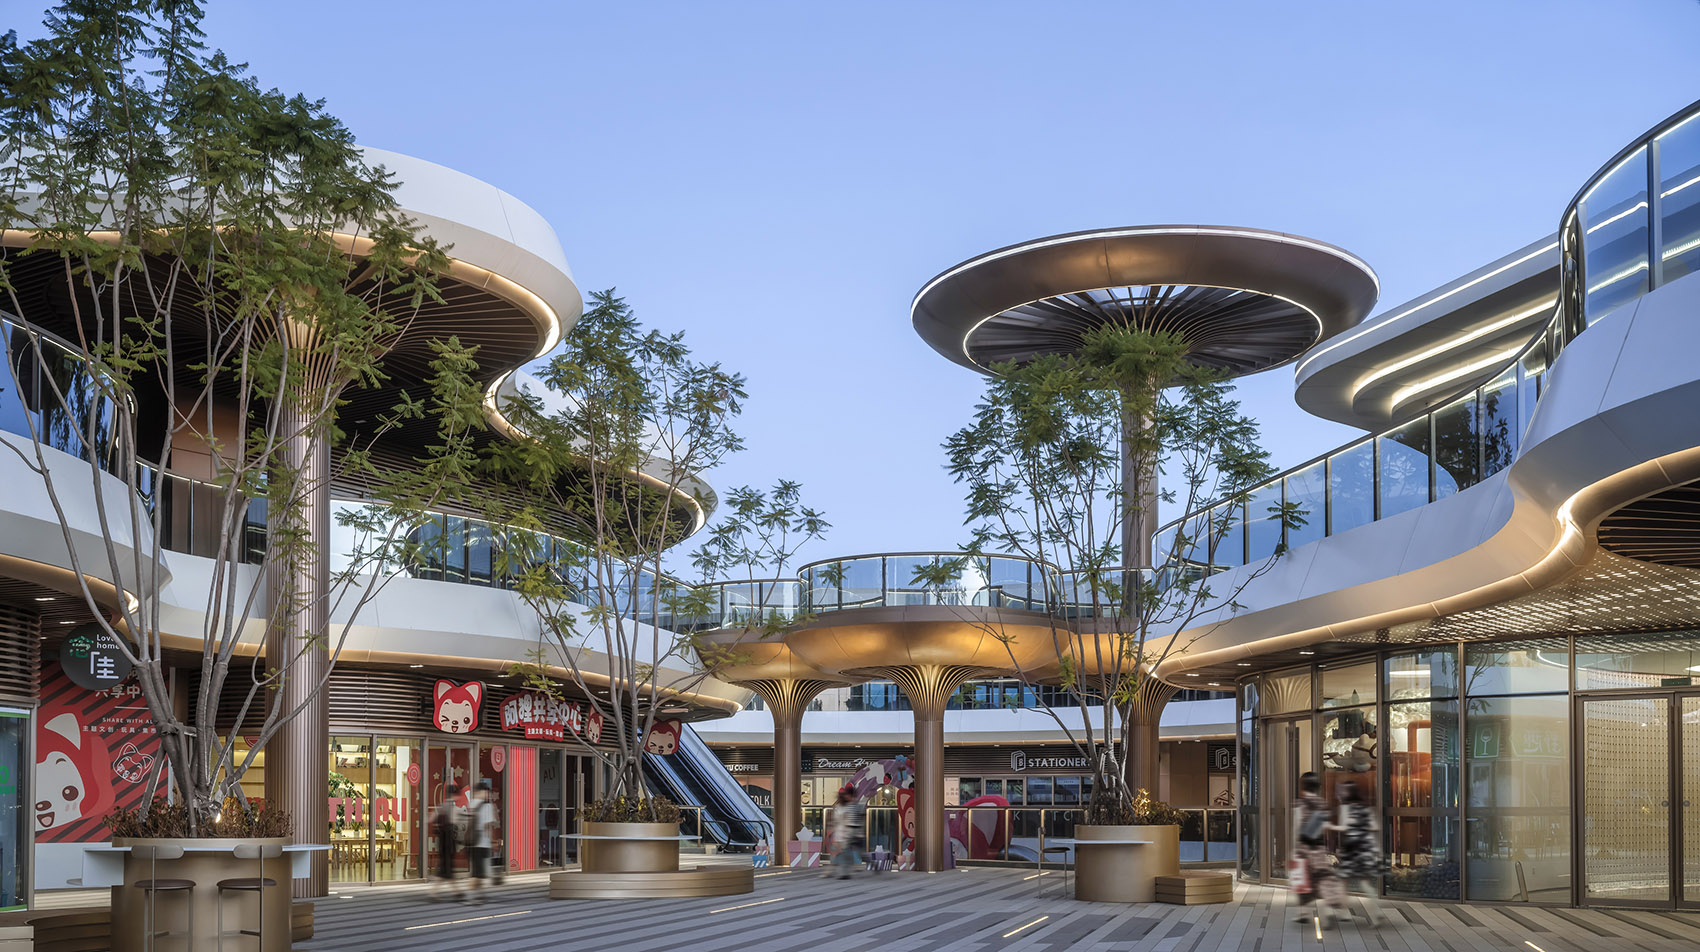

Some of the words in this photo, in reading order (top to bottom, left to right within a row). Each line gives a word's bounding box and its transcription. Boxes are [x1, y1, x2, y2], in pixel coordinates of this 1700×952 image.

[504, 694, 582, 731] 阿狸共享中心
[817, 758, 852, 768] Dream
